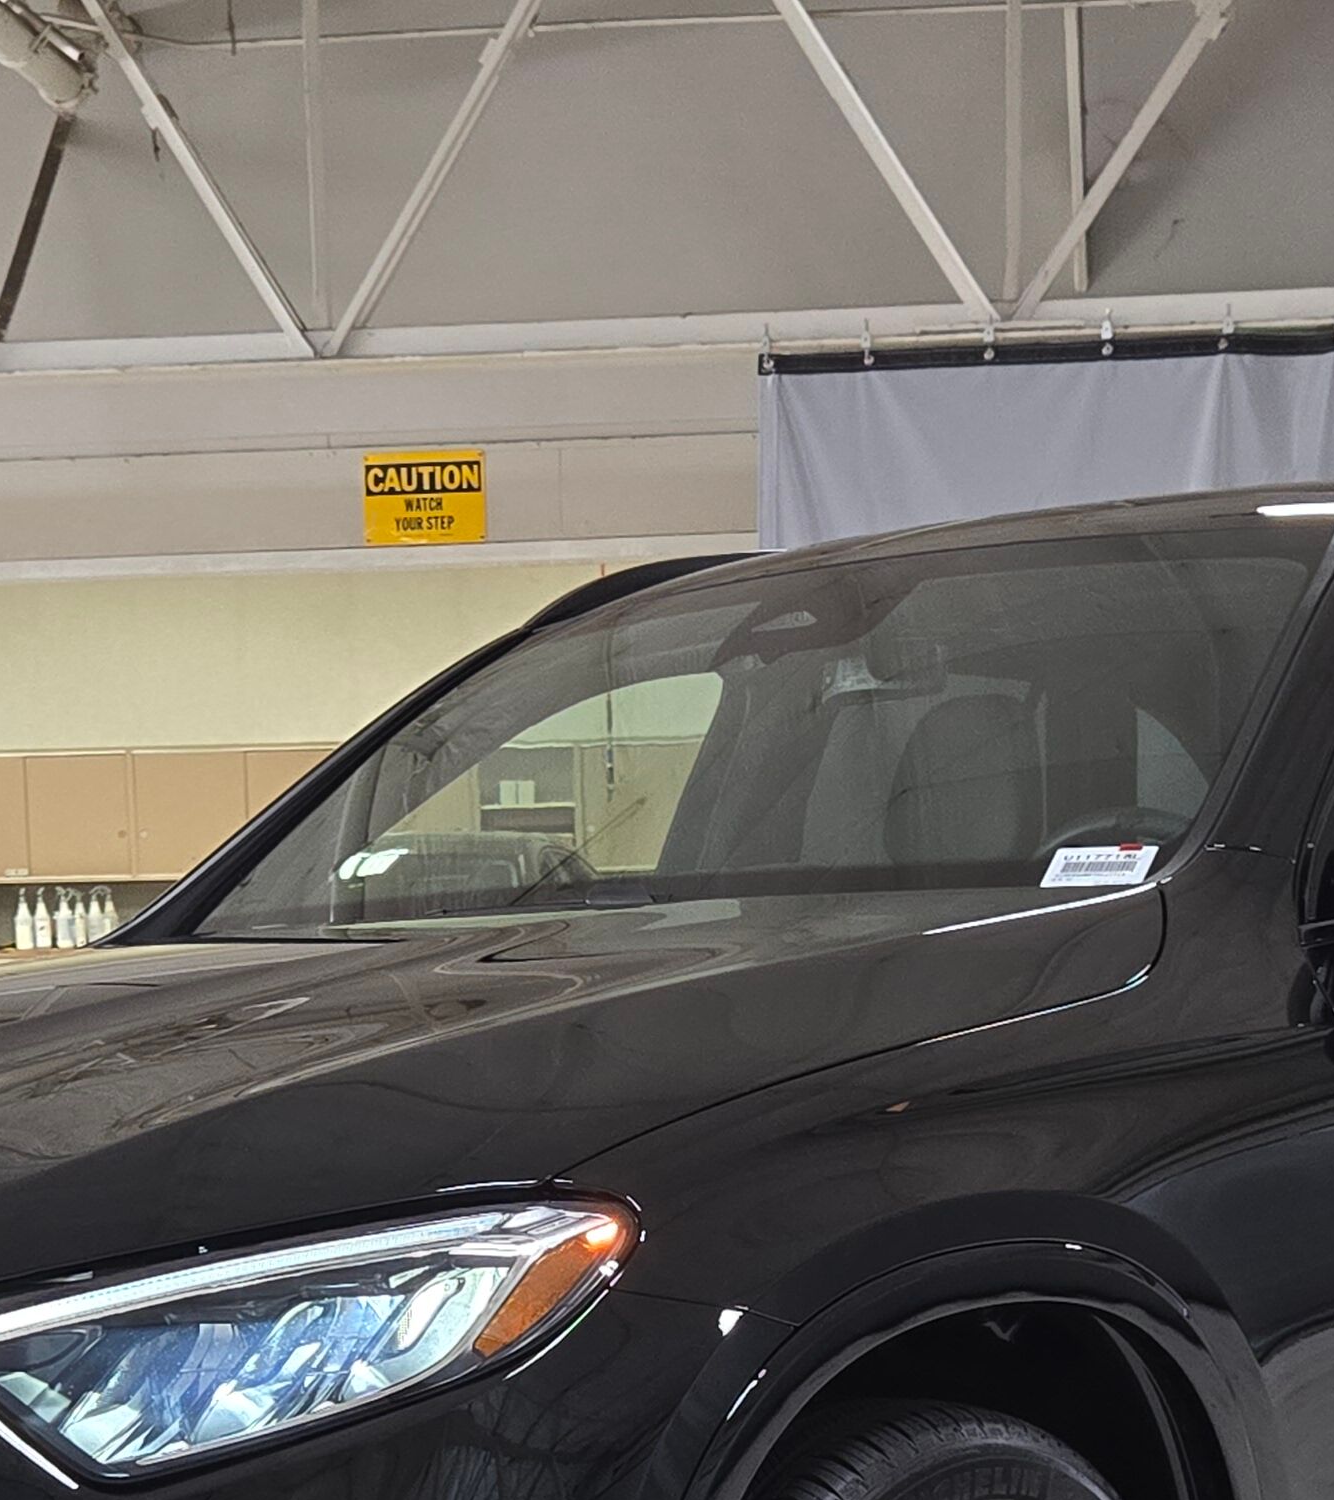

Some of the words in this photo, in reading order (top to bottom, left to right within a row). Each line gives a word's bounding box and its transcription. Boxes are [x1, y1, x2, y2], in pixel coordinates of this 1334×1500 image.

[367, 464, 480, 493] CAUTION
[404, 497, 443, 512] WATCH
[395, 517, 424, 531] YOUR
[426, 515, 455, 530] STEP
